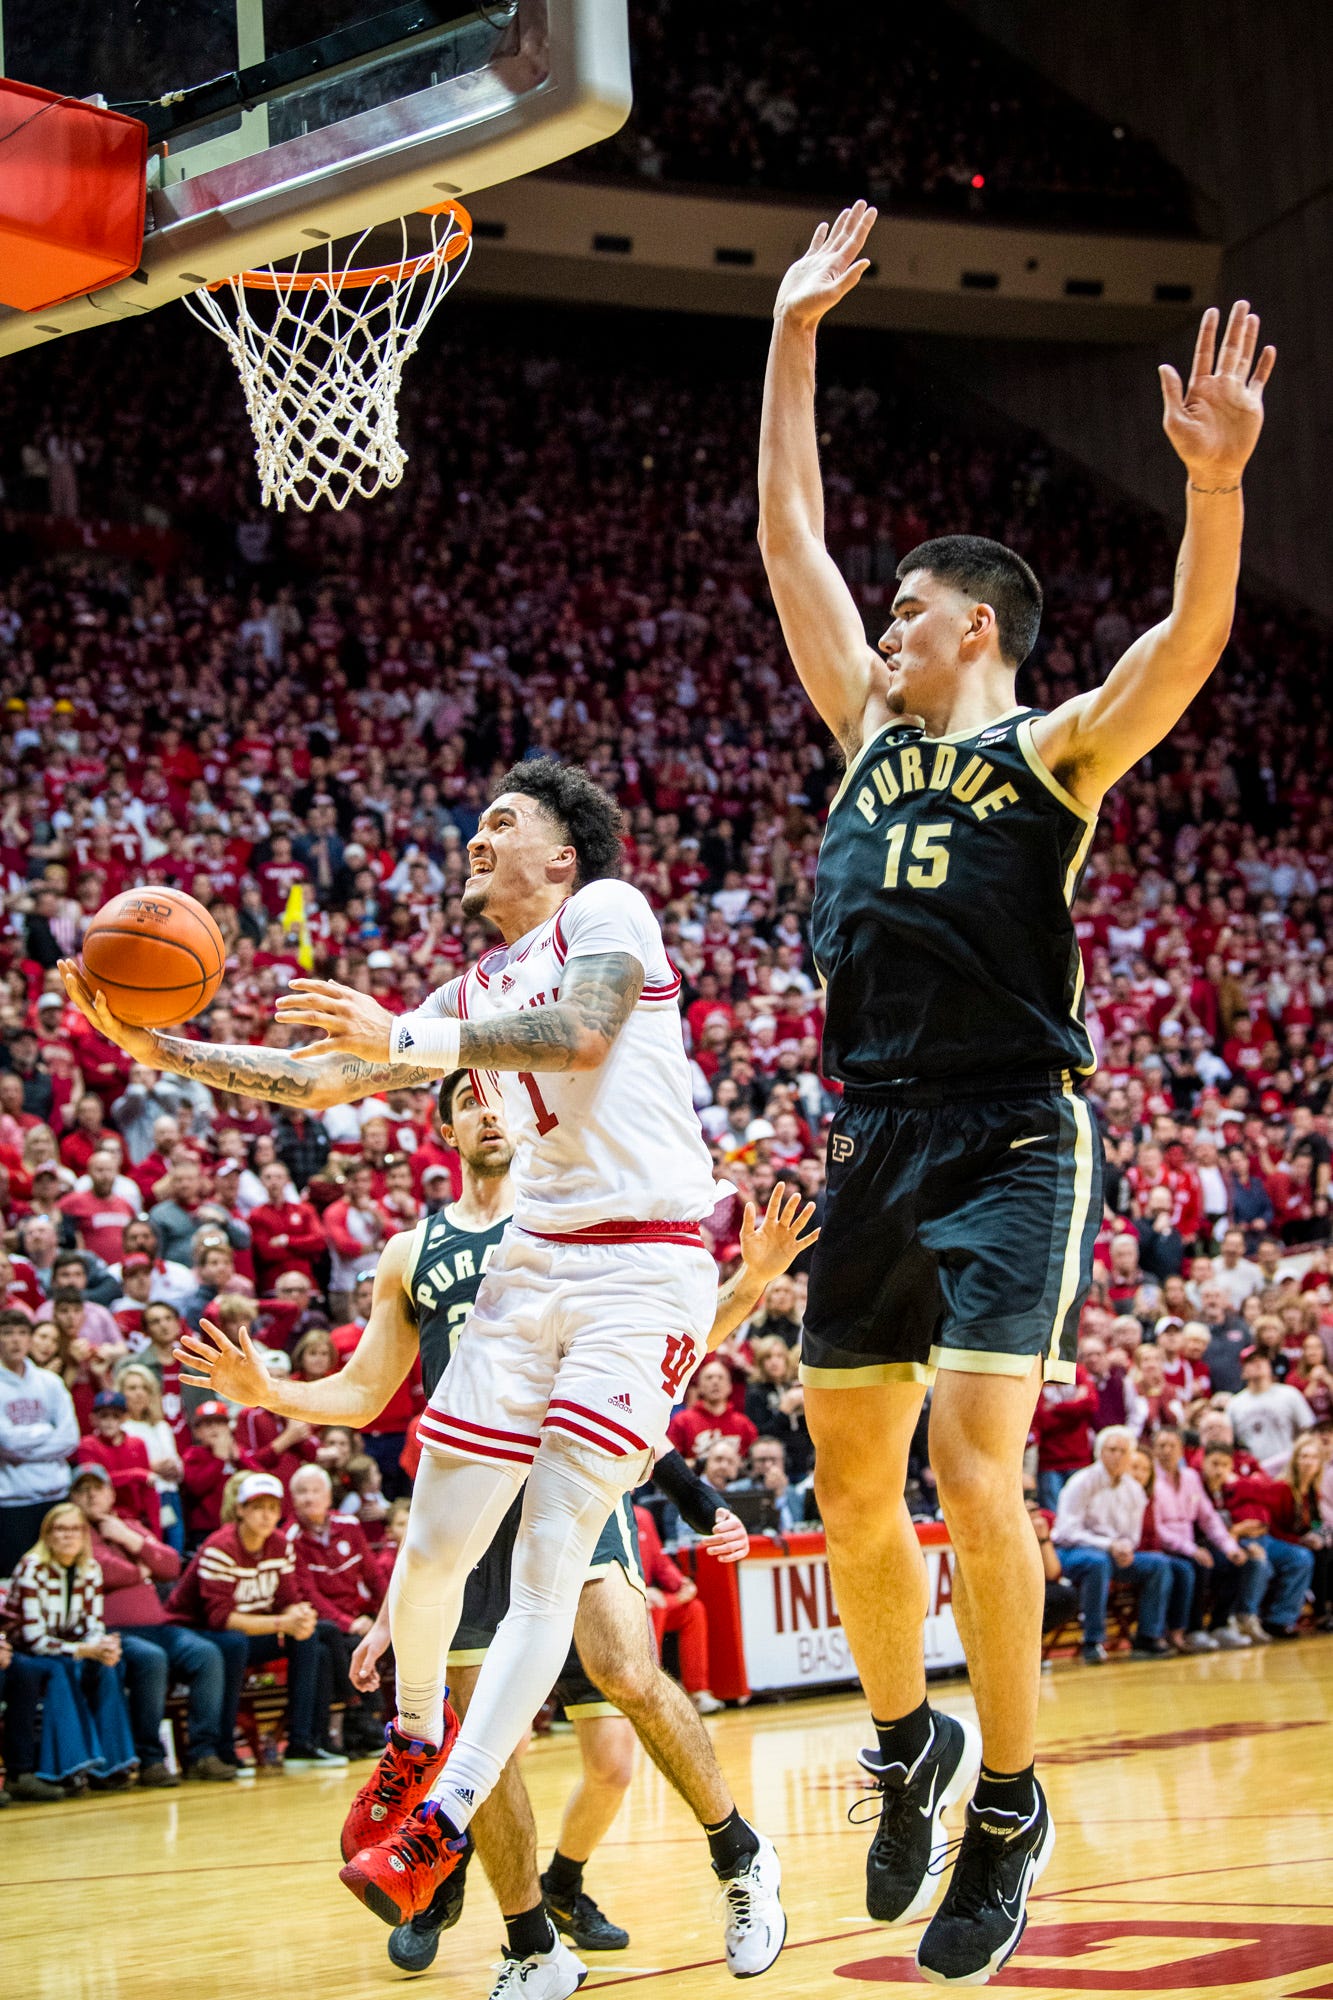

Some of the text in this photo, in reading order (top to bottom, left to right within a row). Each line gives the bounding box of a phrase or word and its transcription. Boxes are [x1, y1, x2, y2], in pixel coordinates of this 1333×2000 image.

[856, 744, 1020, 825] PURDUE
[882, 823, 952, 889] 15
[518, 1072, 559, 1137] 1
[832, 1133, 855, 1163] P
[607, 1397, 633, 1414] adidas
